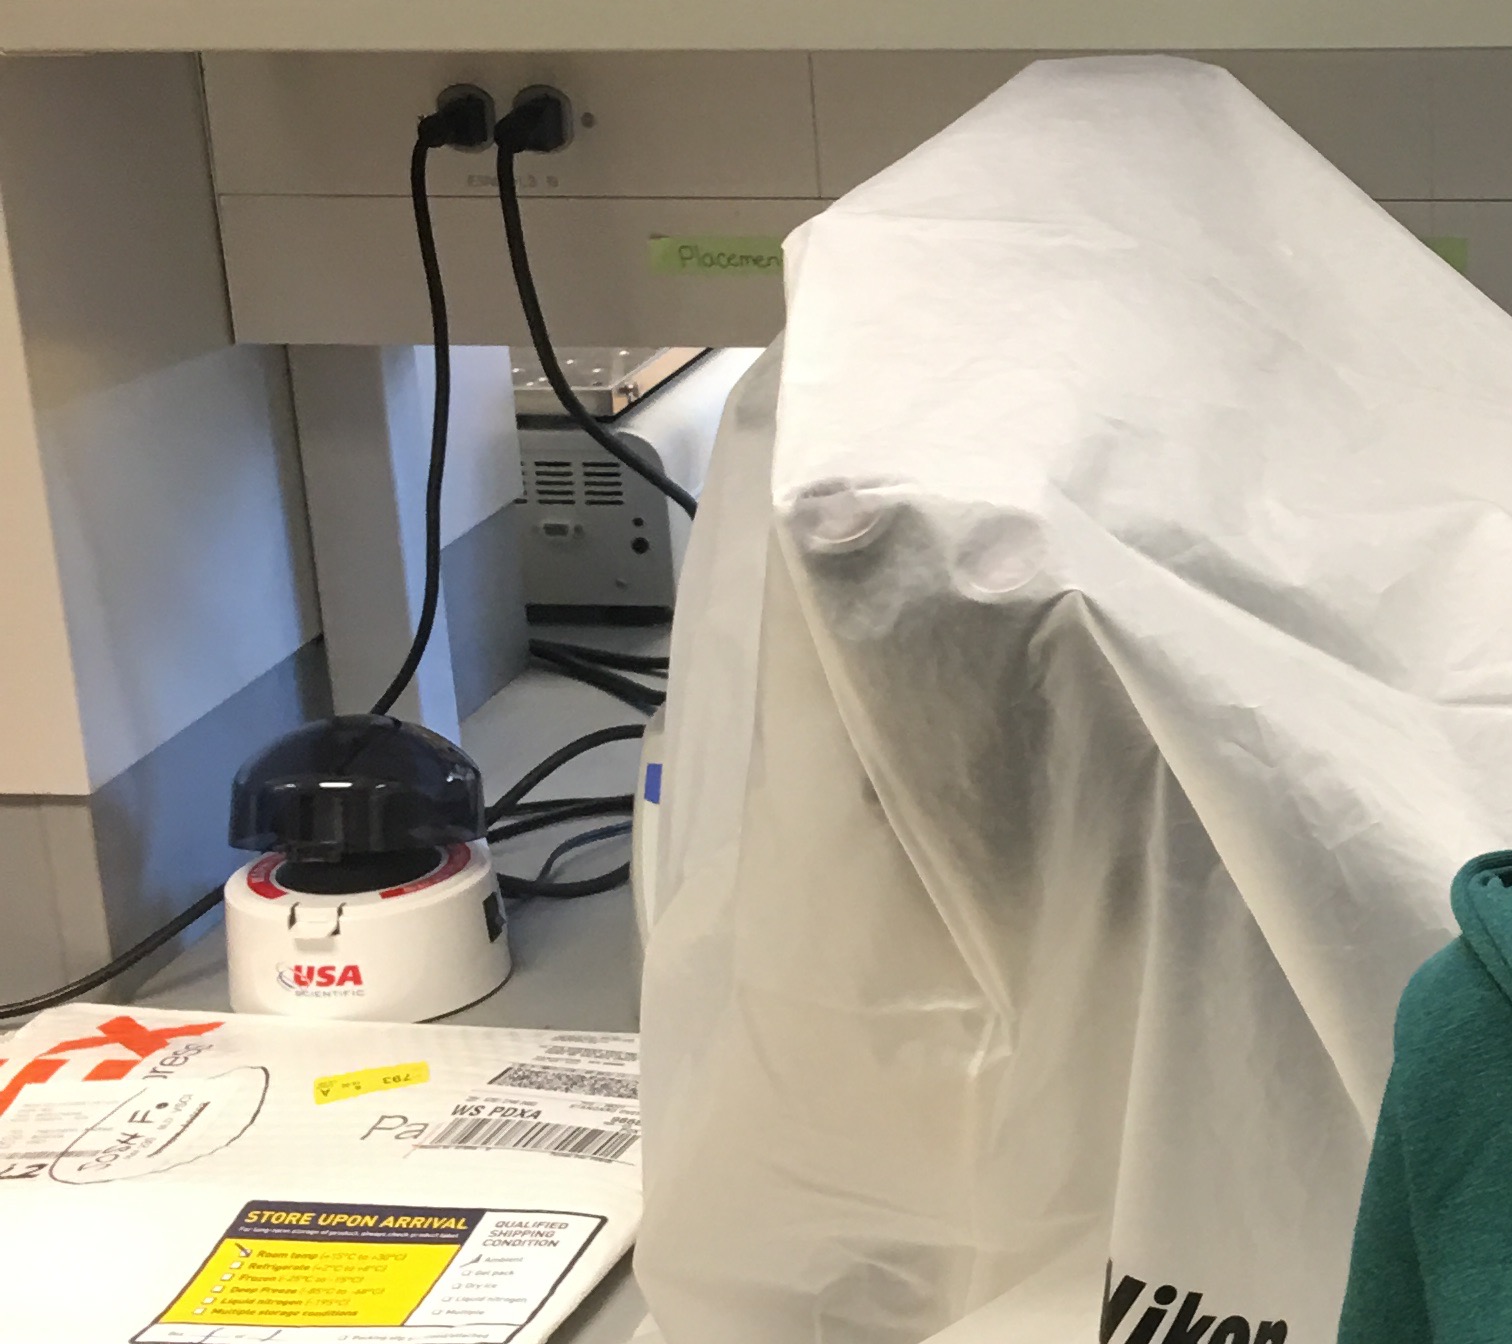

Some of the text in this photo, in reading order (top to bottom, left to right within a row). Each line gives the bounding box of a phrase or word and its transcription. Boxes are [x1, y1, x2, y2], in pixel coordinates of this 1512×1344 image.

[678, 244, 784, 268] Placemen
[293, 964, 364, 987] USA
[295, 989, 366, 998] SCIENTIFIC
[451, 1103, 543, 1120] WS PDXA
[360, 1114, 430, 1141] Pa
[244, 1210, 469, 1231] STORE UPON ARRIVAL
[494, 1220, 570, 1230] QUALIFIED
[488, 1229, 557, 1239] SHIPPING
[482, 1238, 560, 1248] CONDITION
[256, 1250, 289, 1259] Room
[290, 1252, 319, 1262] temp
[248, 1262, 311, 1273] Refrigerate
[238, 1274, 277, 1283] Frozen
[229, 1286, 259, 1296] Deep
[260, 1287, 298, 1295] Freeze
[220, 1298, 303, 1308] Liquid nitrogen
[210, 1308, 359, 1318] Multiple storage conditions
